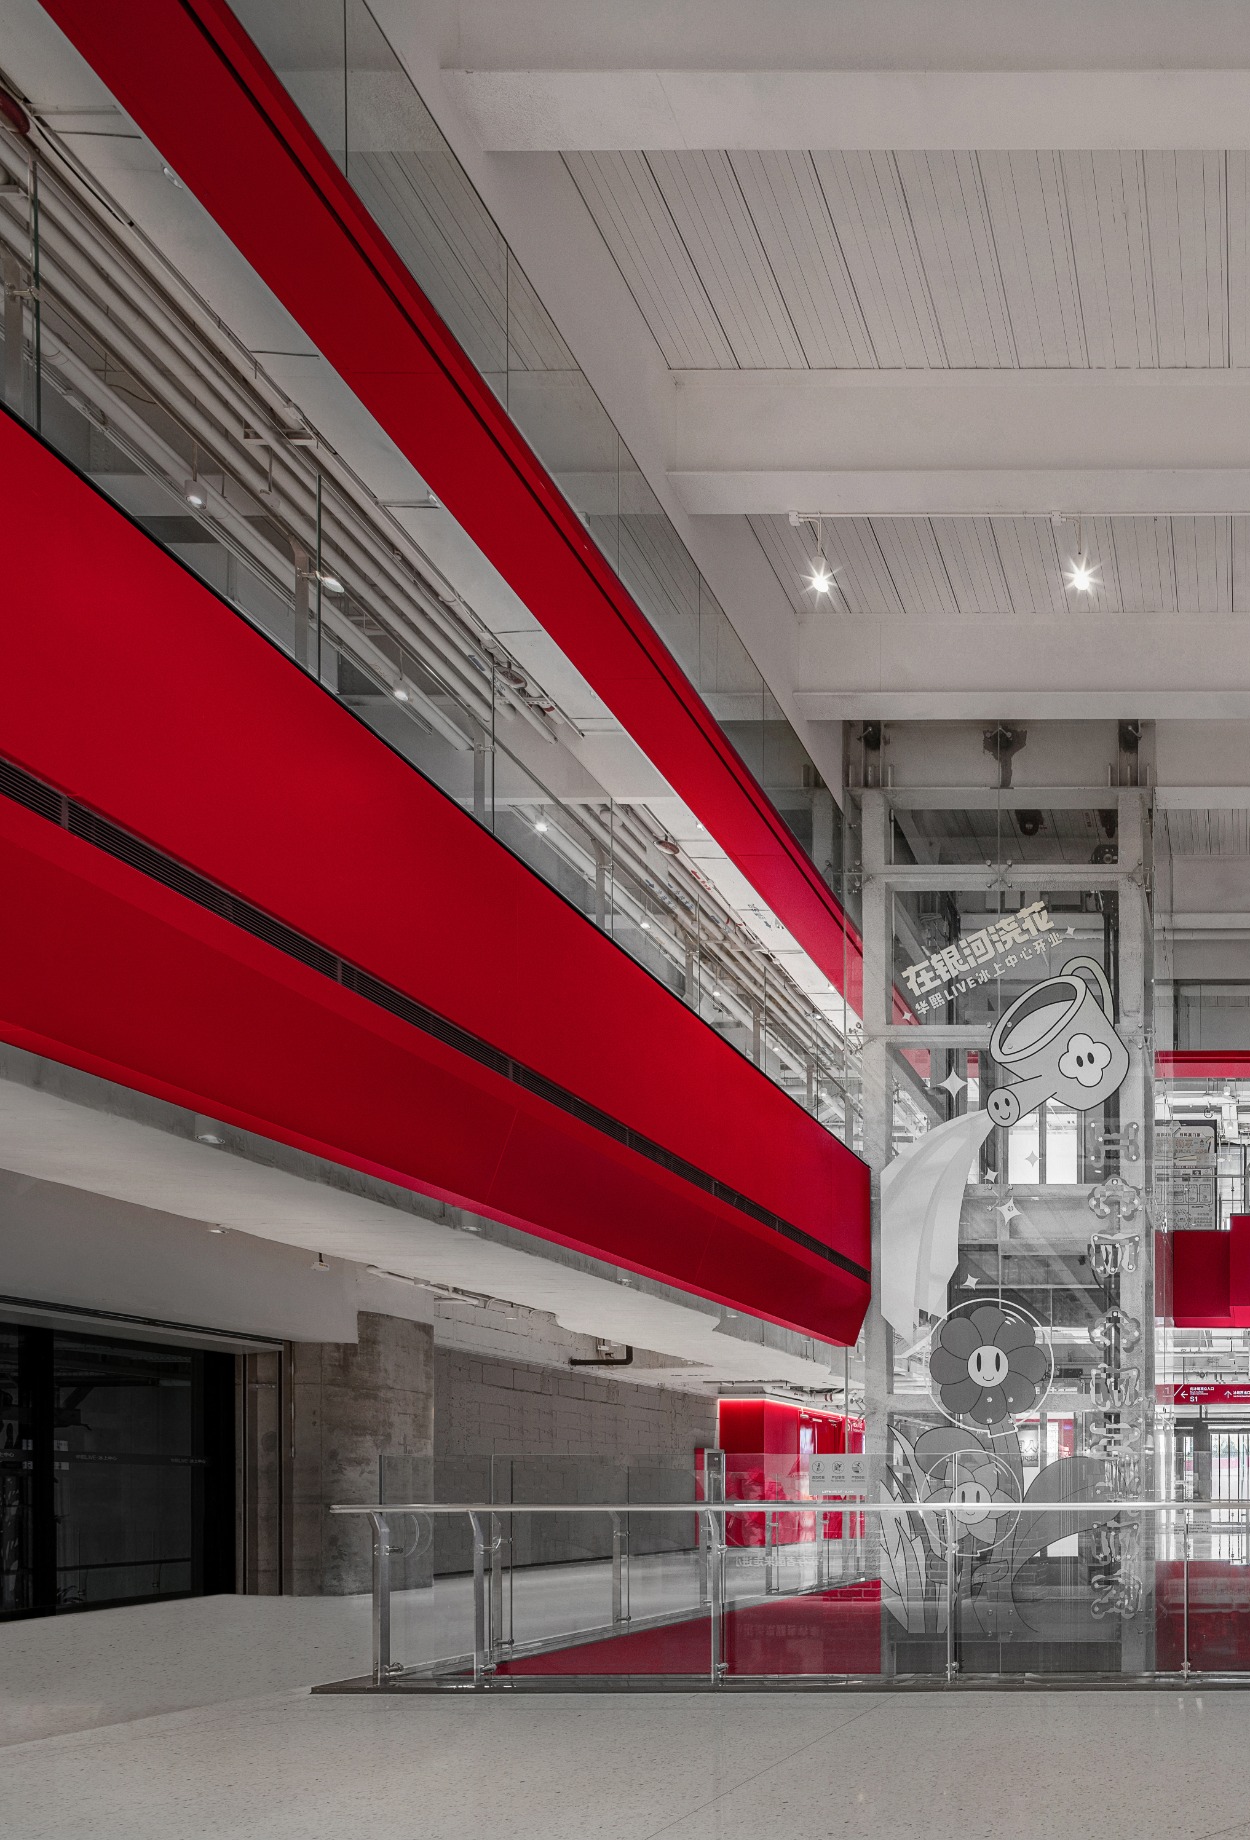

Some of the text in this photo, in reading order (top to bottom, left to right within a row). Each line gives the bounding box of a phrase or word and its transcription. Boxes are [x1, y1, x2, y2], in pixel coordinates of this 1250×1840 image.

[901, 900, 1055, 997] 在银河浇花
